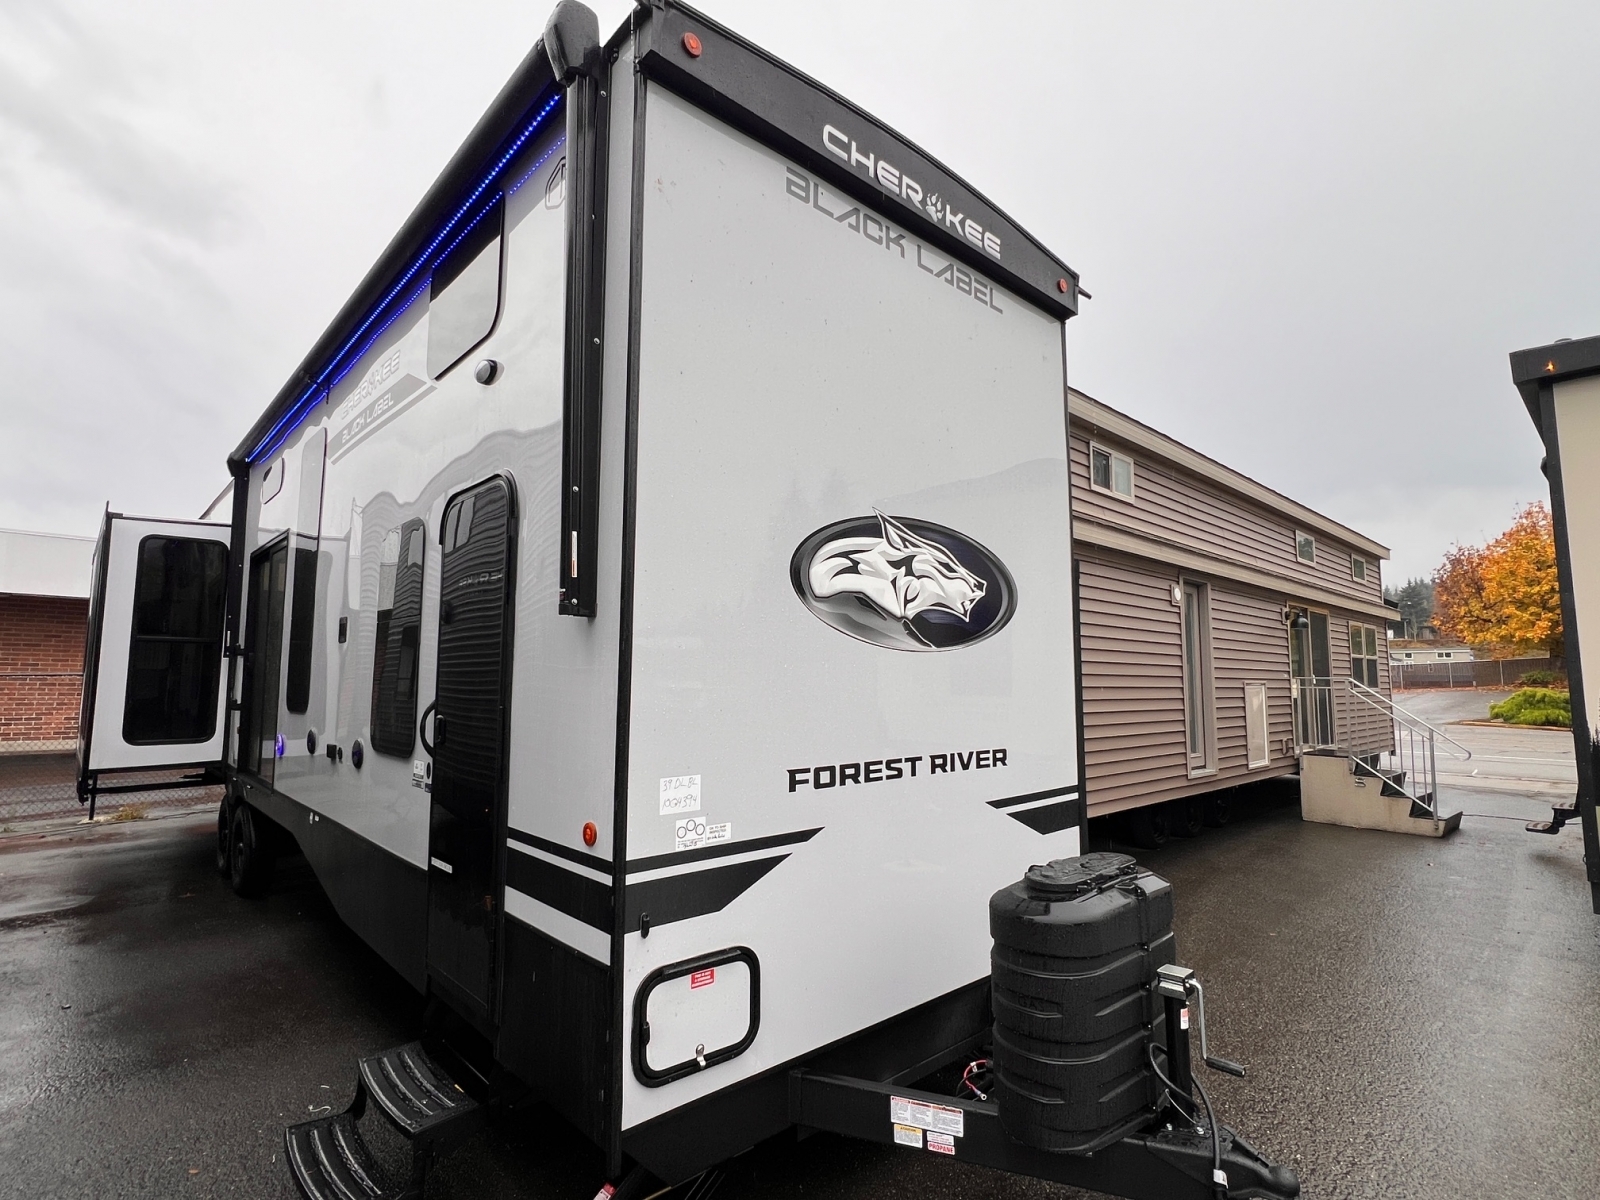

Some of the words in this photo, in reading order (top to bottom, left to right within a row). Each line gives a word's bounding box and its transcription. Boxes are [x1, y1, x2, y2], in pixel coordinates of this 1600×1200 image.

[786, 166, 906, 259] BLACK
[917, 244, 1003, 314] LABEL
[342, 414, 365, 443] BLACK
[366, 393, 394, 423] LABEL
[786, 756, 923, 793] FOREST
[929, 748, 1008, 775] RIVER
[929, 1143, 953, 1153] PROPANE
